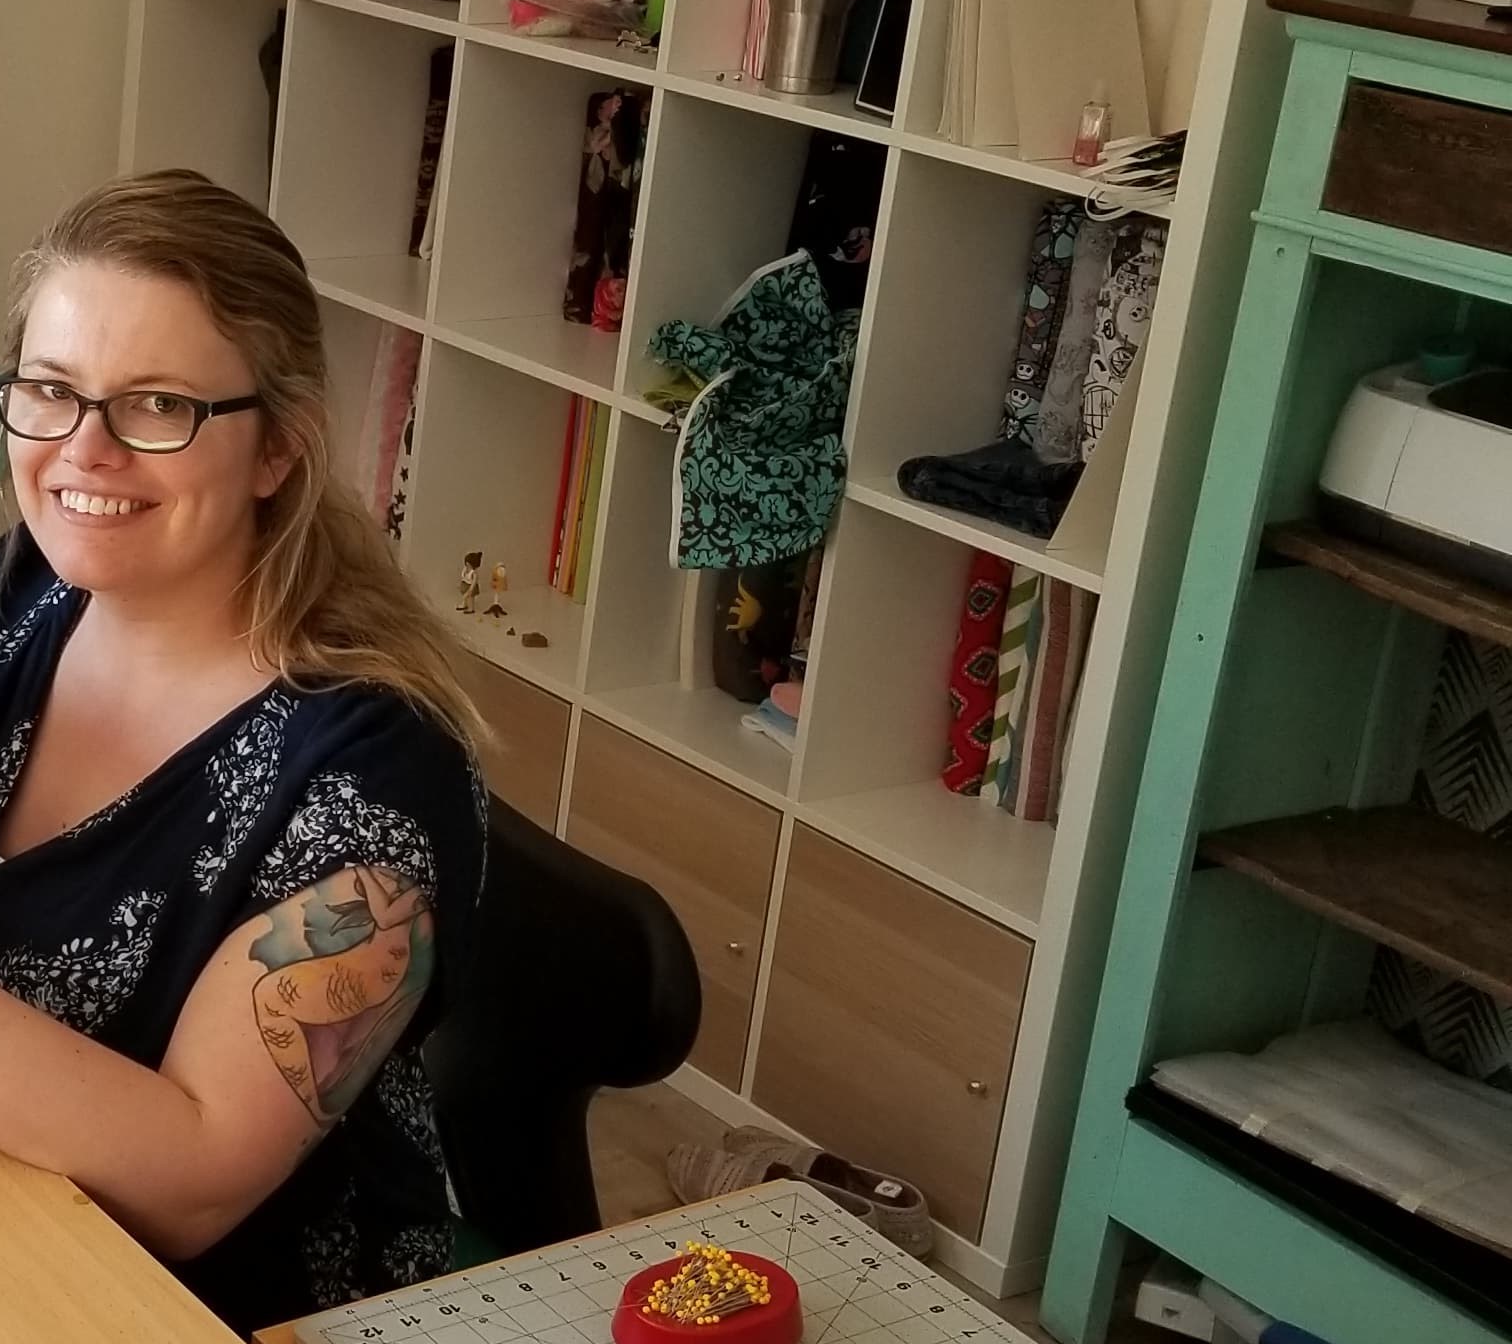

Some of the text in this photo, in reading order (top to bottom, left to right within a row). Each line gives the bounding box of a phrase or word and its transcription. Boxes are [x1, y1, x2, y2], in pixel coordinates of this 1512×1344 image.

[799, 1212, 820, 1227] 12
[828, 1235, 851, 1248] 11
[861, 1257, 882, 1271] 10
[439, 1304, 461, 1316] 10
[400, 1315, 422, 1327] 11
[360, 1326, 384, 1339] 12
